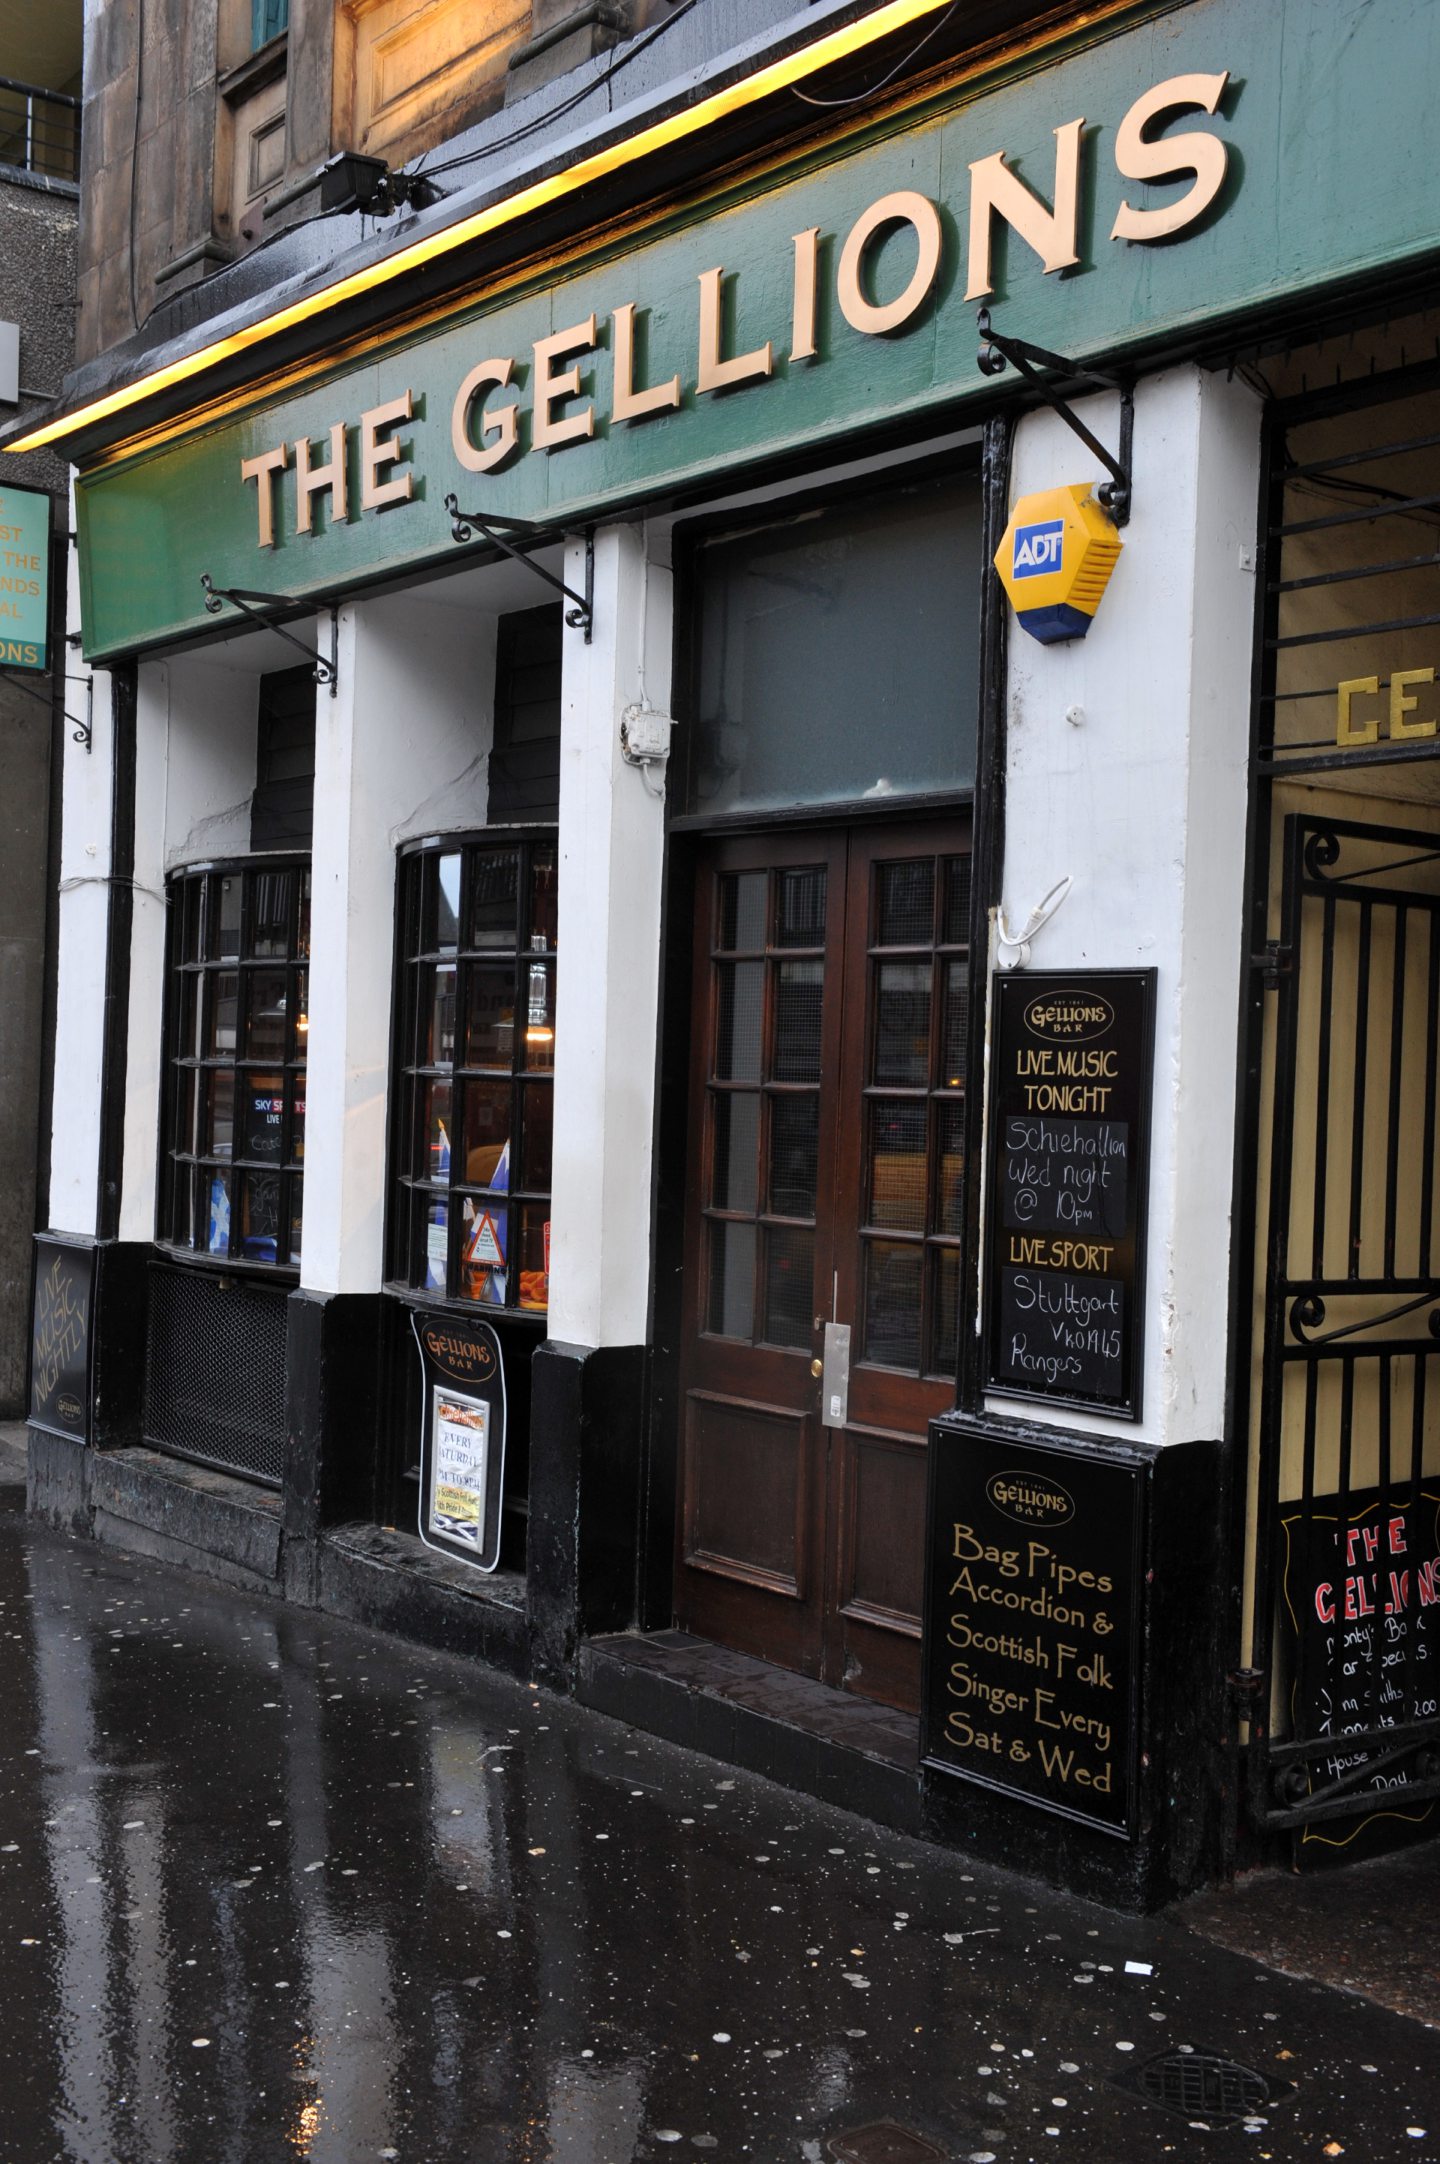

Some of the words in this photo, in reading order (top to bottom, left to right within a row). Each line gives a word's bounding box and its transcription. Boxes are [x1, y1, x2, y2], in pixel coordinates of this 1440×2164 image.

[242, 389, 414, 549] THE
[451, 70, 1230, 473] GELLIONS
[4, 551, 40, 571] THE
[1014, 531, 1063, 568] ADT
[1053, 1024, 1083, 1033] BAR
[1016, 1050, 1055, 1076] LIVE
[1057, 1050, 1118, 1077] MUSIC
[254, 1099, 271, 1111] SKY
[1024, 1085, 1111, 1113] TONIGHT
[1006, 1120, 1126, 1158] Schiehallion
[1008, 1157, 1051, 1187] Wed
[1063, 1160, 1111, 1202] night
[1014, 1188, 1038, 1221] @
[1010, 1236, 1048, 1265] LIVE
[1049, 1240, 1114, 1272] SPORT
[1014, 1275, 1118, 1326] Stuttgart
[448, 1356, 473, 1371] BAR
[1011, 1332, 1082, 1383] Rangers
[439, 1447, 480, 1468] ATURDAY
[1015, 1504, 1044, 1519] BAR
[952, 1523, 1020, 1577] Bag
[1028, 1541, 1112, 1593] Pipes
[949, 1567, 1085, 1628] Accordion
[1093, 1612, 1114, 1635] &
[947, 1614, 1049, 1669] Scottish
[1056, 1643, 1113, 1690] Folk
[947, 1663, 1029, 1714] Singer
[1035, 1688, 1111, 1751] Every
[944, 1712, 1002, 1754] Sat
[1009, 1739, 1031, 1762] &
[1038, 1739, 1111, 1793] Wed
[1326, 1752, 1369, 1780] House
